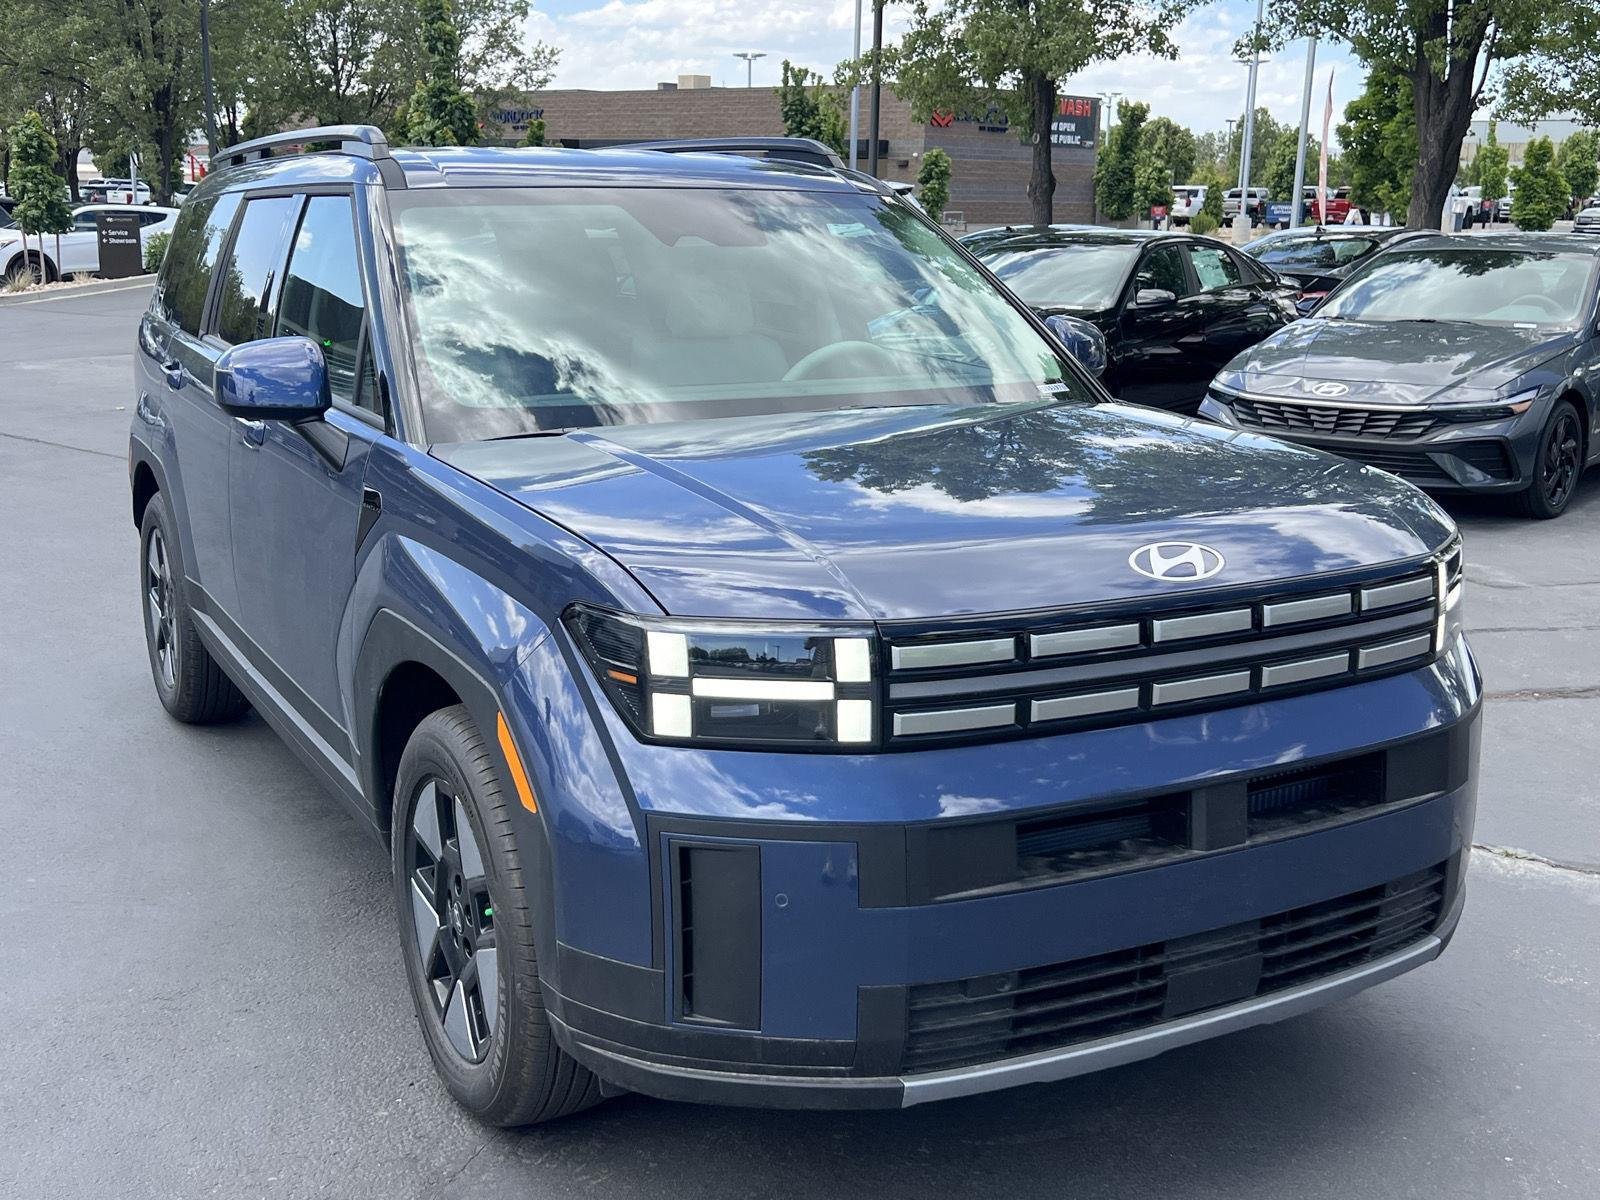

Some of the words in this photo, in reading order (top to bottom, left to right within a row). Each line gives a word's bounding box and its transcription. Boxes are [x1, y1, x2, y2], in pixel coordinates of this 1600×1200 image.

[1059, 122, 1075, 131] OPEN
[1059, 134, 1081, 145] PUBLIC
[489, 973, 506, 1088] ASSURANCE
